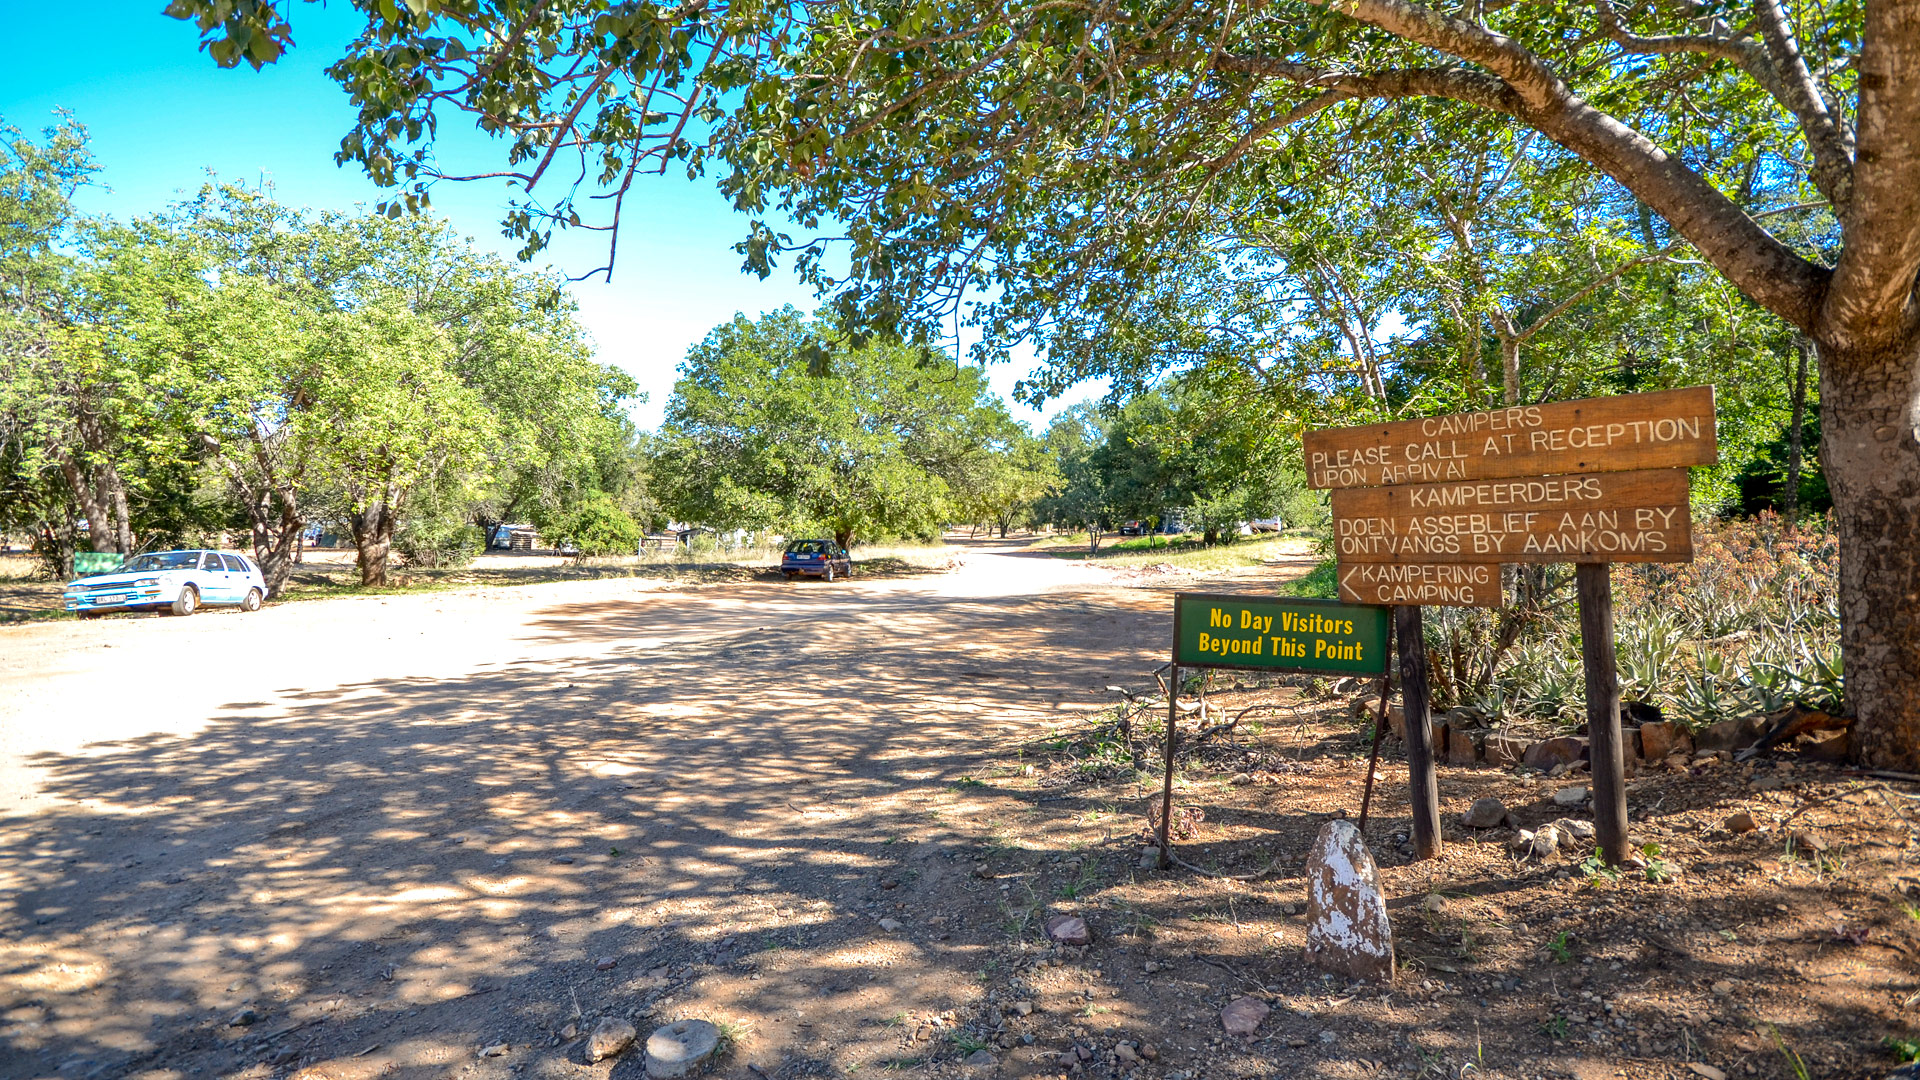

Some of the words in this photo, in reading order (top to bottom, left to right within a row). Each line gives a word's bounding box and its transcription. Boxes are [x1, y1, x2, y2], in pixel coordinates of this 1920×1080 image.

[1422, 407, 1543, 437] CAMPERS
[1312, 445, 1392, 469] PLEASE
[1405, 441, 1468, 462] CALL
[1483, 434, 1517, 455] AT
[1530, 416, 1700, 451] RECEPTION
[1313, 468, 1367, 488] UPON
[1410, 478, 1602, 507] KAMPEERDERS
[1340, 517, 1395, 536] DOEN
[1408, 512, 1539, 535] ASSEBLIEF
[1558, 510, 1618, 531] AAN
[1635, 507, 1676, 530] BY
[1341, 535, 1460, 554] ONTVANGS
[1473, 534, 1506, 553] BY
[1523, 529, 1667, 553] AANKOMS
[1361, 565, 1489, 584] KAMPERING
[1377, 585, 1474, 604] CAMPING
[1210, 608, 1232, 628] No
[1240, 610, 1272, 634] Day
[1282, 611, 1353, 635] Visitors
[1199, 632, 1262, 656] Beyond
[1271, 636, 1306, 658] This
[1315, 639, 1363, 661] Point
